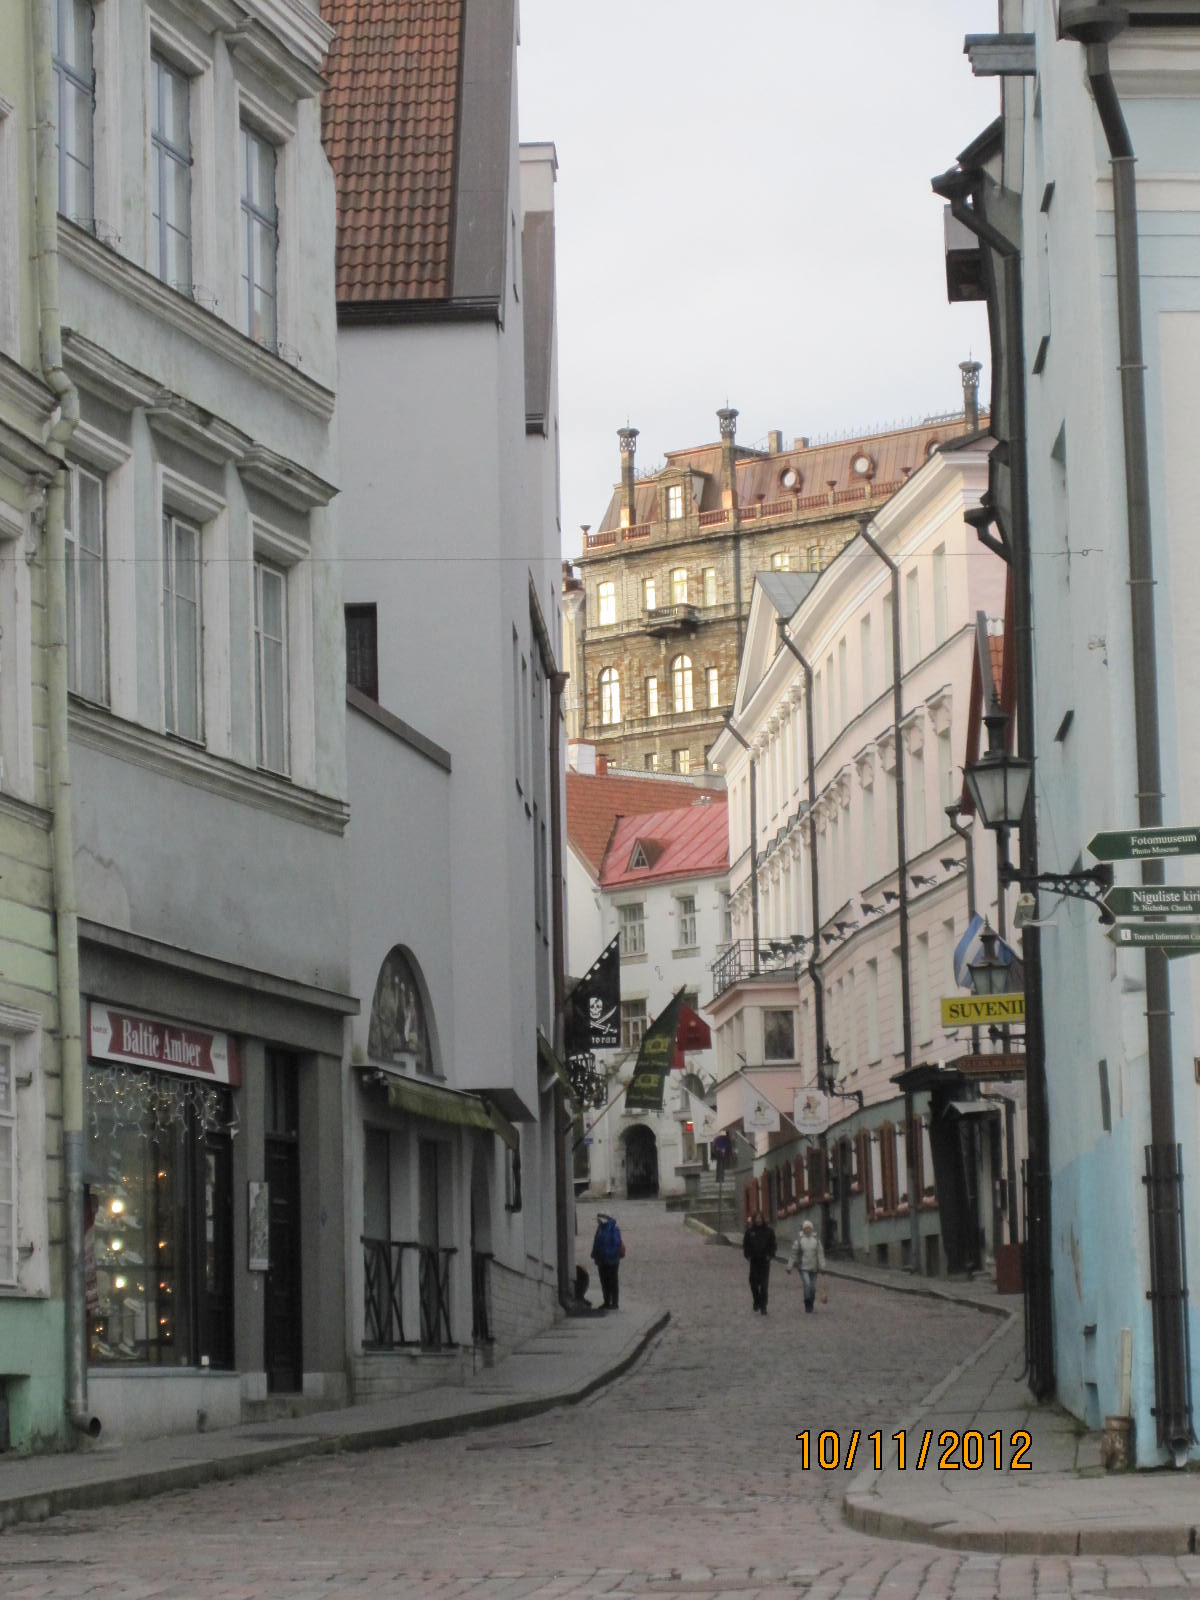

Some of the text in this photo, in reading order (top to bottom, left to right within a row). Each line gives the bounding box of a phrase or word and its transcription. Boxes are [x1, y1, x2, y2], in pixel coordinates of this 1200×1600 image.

[1130, 834, 1197, 846] Fotomuuseum
[1132, 891, 1180, 904] Niguliste
[122, 1019, 200, 1067] Baltic Amber
